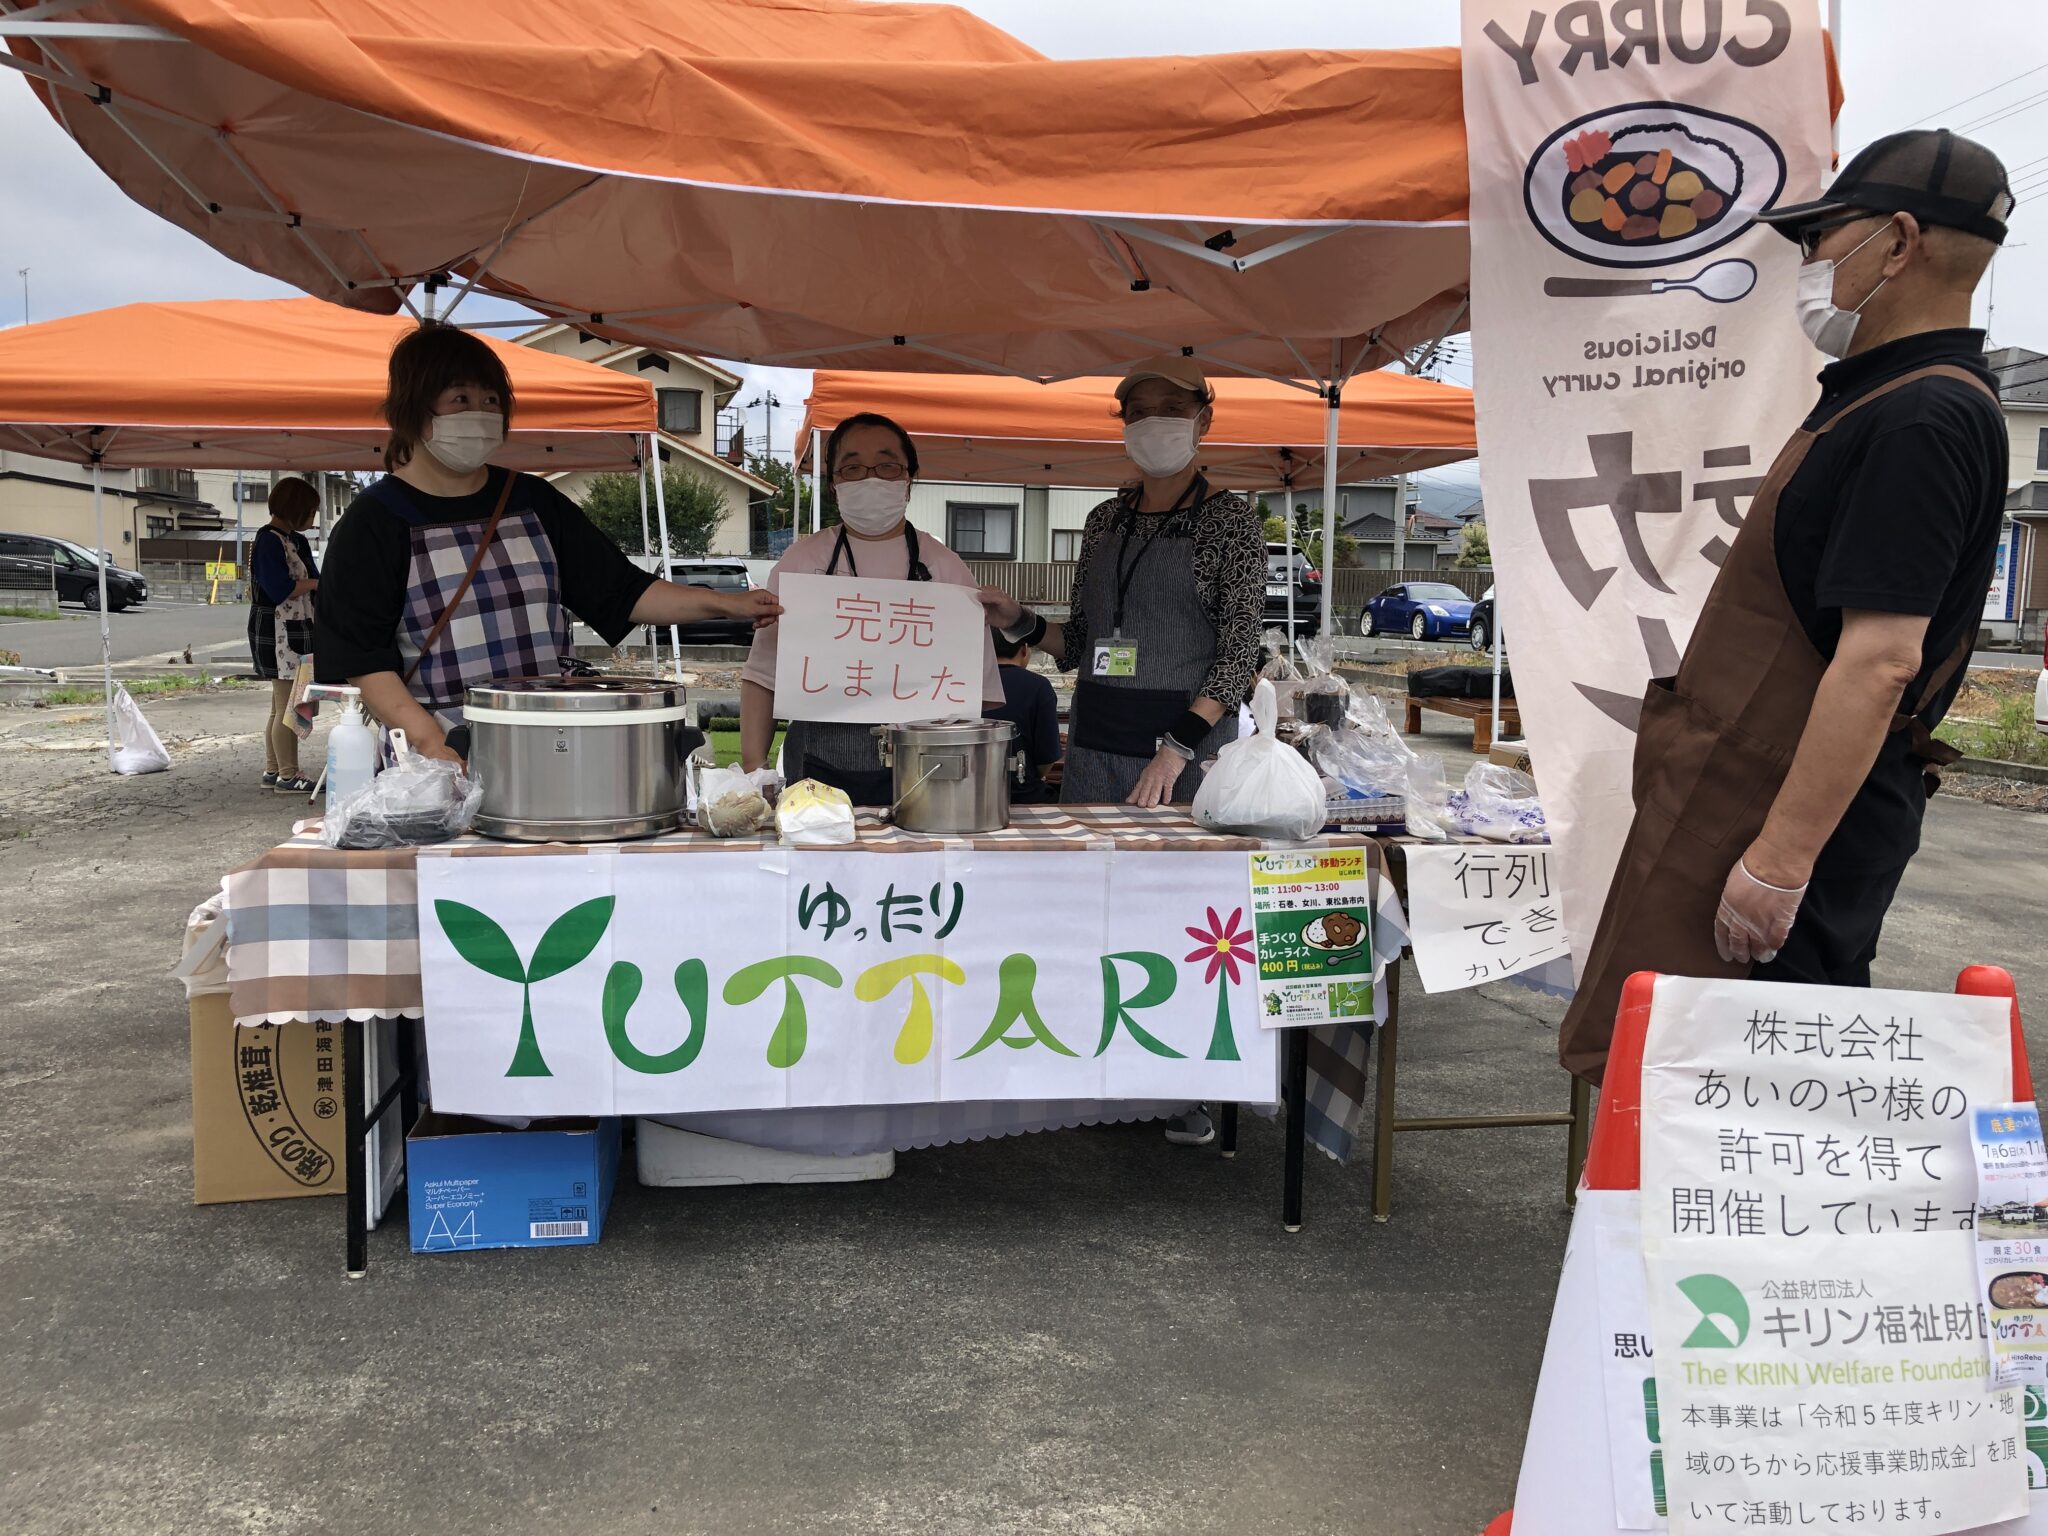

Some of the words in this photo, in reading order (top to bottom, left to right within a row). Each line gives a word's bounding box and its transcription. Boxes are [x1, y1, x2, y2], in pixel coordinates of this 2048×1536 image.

[834, 593, 936, 647] 完売
[802, 656, 966, 702] しました
[1320, 857, 1361, 868] 移動ランチ
[1454, 852, 1551, 900] 行列
[1315, 883, 1340, 891] 13:00
[798, 880, 964, 943] ゆったり
[1463, 905, 1558, 946] でき
[1259, 932, 1297, 945] 手づくり
[1260, 946, 1311, 960] カレーライス
[1465, 936, 1569, 981] カレー
[434, 895, 1256, 1076] YUTTARI
[1743, 1009, 1924, 1062] 株式会社
[1694, 1069, 1967, 1122] あいのや様の
[1717, 1128, 1942, 1181] 許可を得て
[425, 1202, 446, 1210] Super
[423, 1209, 482, 1250] A4
[1761, 1279, 1873, 1301] 公益財団法人
[1681, 1361, 1727, 1386] The
[1736, 1361, 1799, 1386] KIRIN
[1807, 1359, 1894, 1385] Welfare
[1690, 1497, 1944, 1526] いて活動しております。
